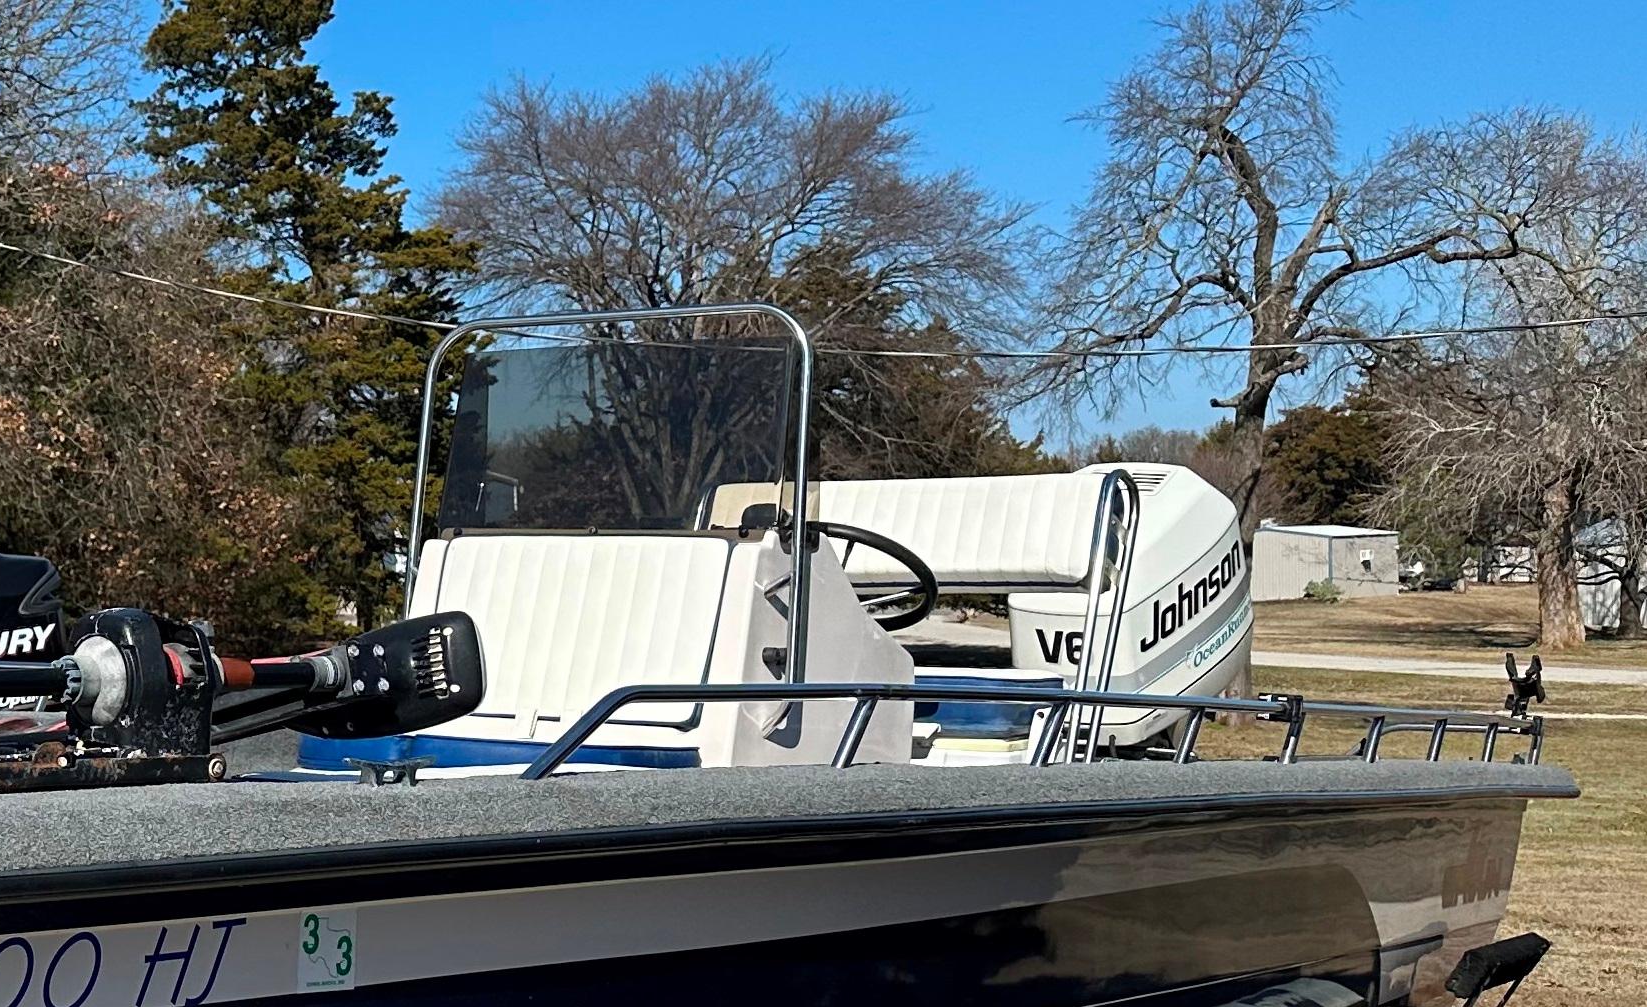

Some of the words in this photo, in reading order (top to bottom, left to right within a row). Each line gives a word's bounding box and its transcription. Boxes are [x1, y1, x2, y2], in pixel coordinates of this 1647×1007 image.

[1140, 540, 1241, 652] Johnson
[1035, 628, 1084, 665] V6
[302, 913, 320, 955] 3
[136, 918, 247, 1007] HJ
[336, 935, 353, 977] 3
